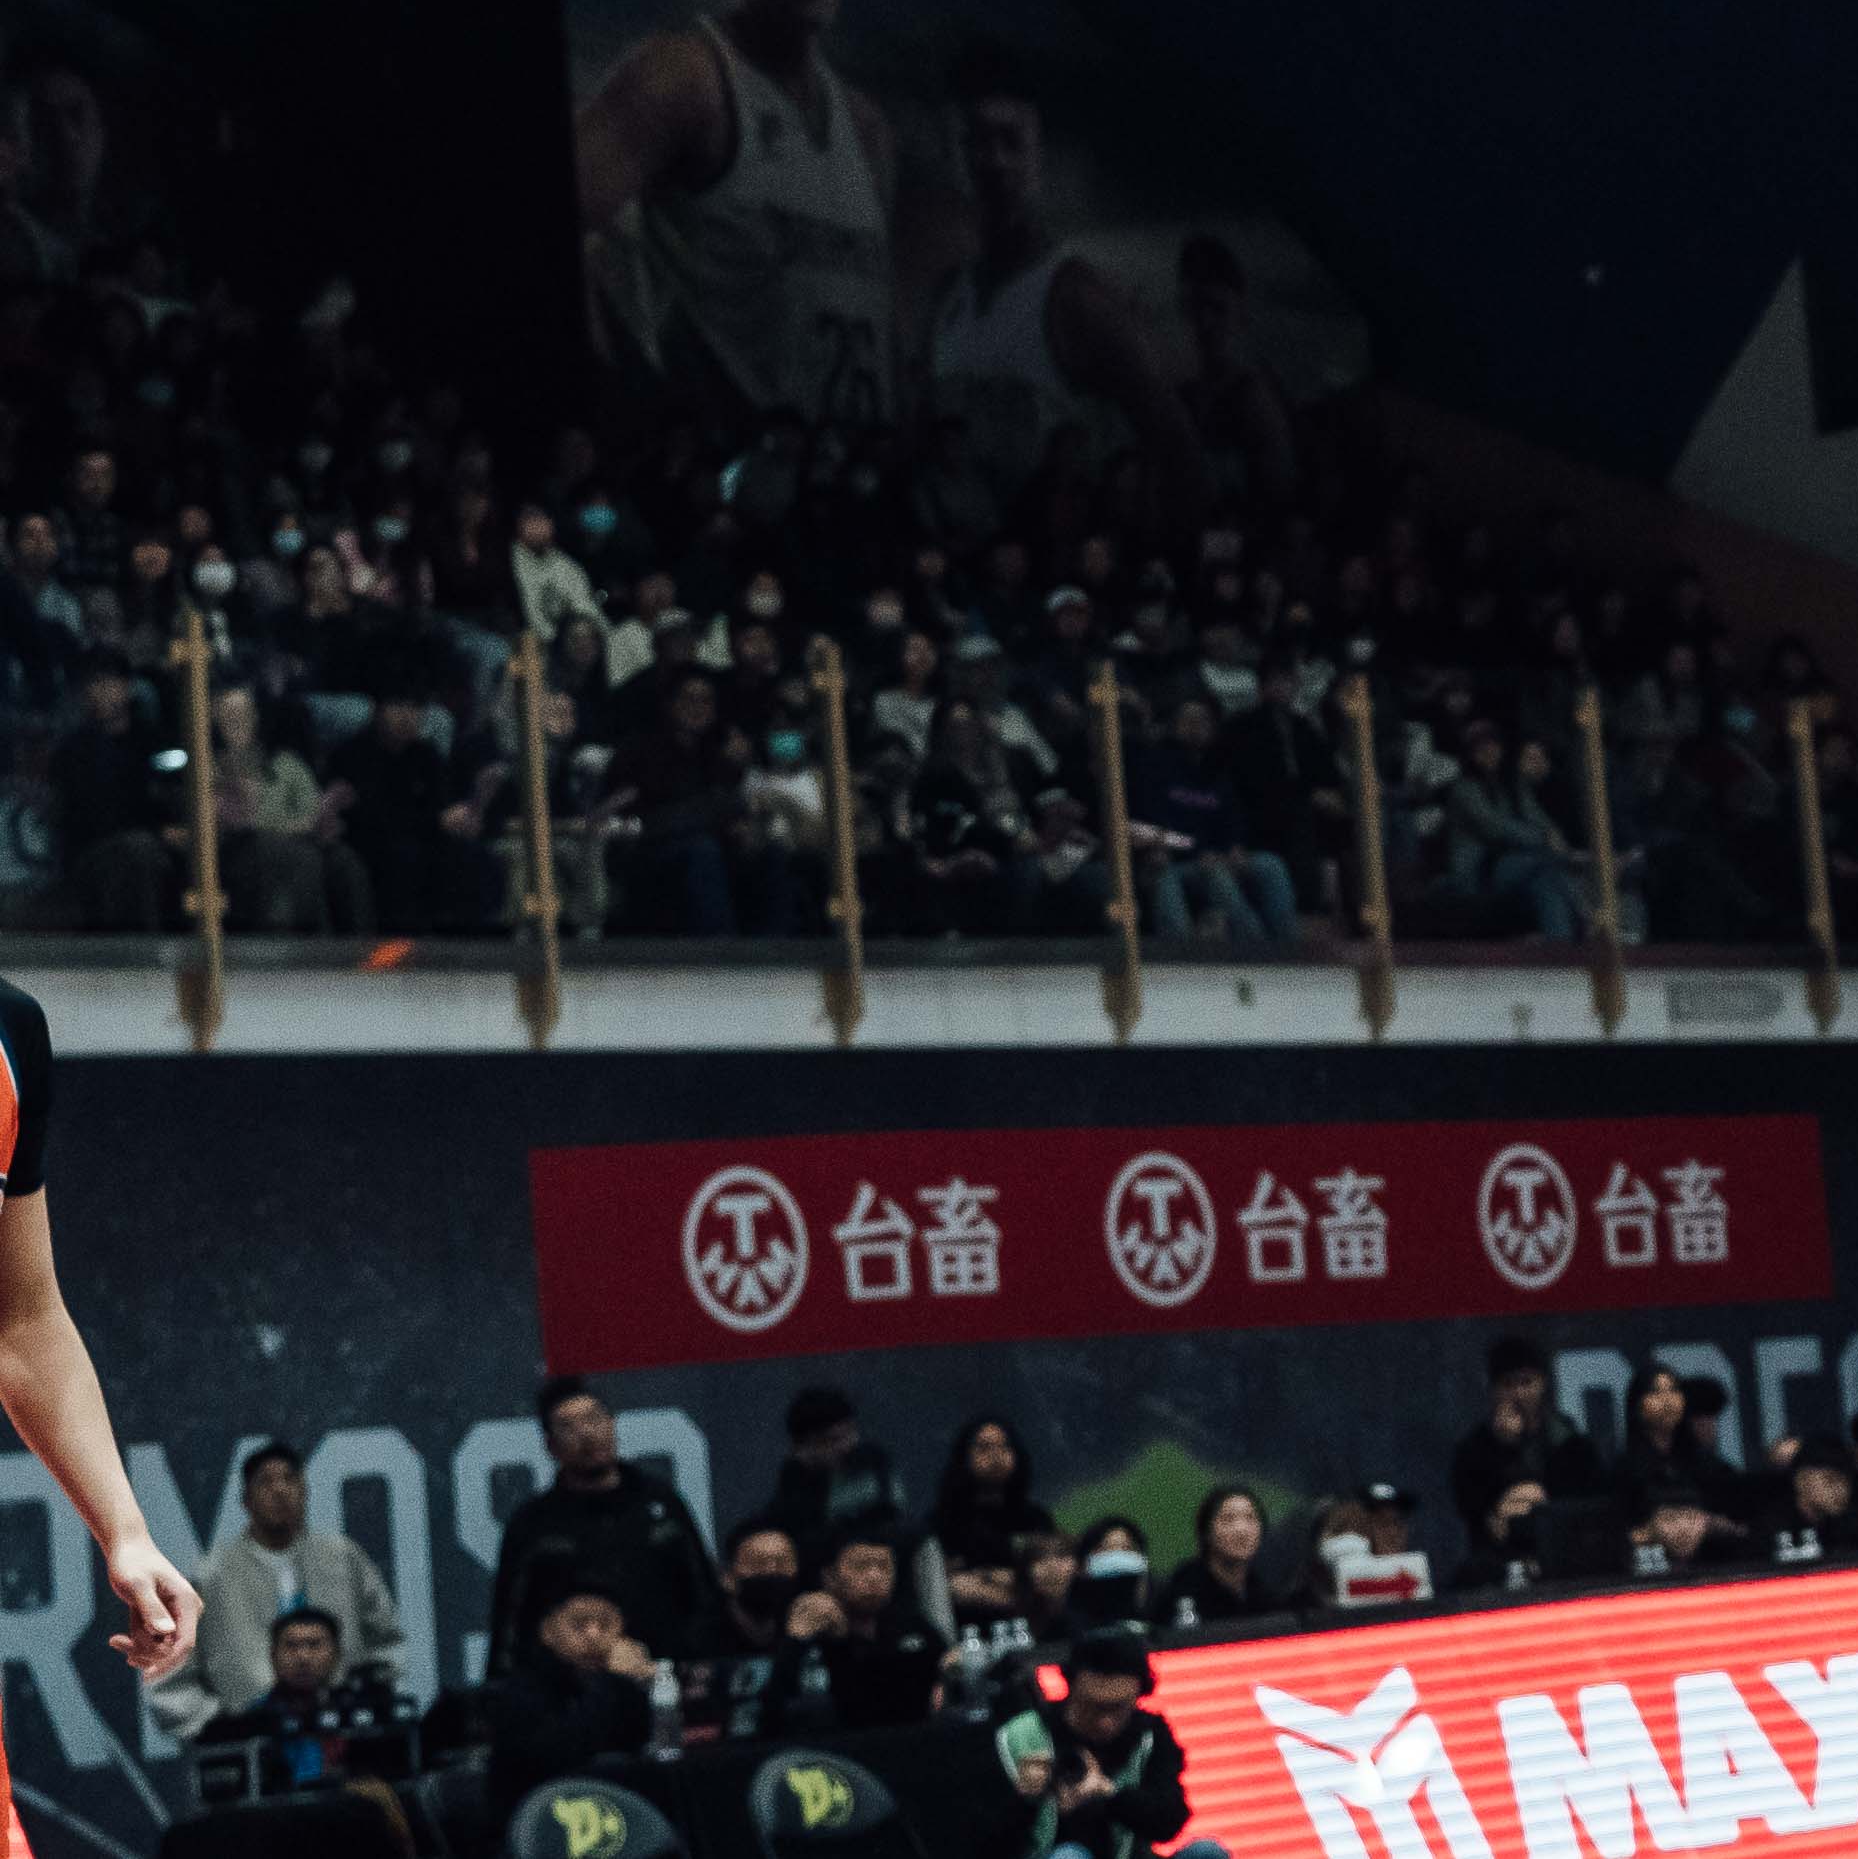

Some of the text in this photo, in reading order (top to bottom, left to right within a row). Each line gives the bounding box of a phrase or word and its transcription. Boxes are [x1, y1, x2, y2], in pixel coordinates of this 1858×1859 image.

[831, 1176, 1001, 1303] 台畜
[1235, 1165, 1389, 1282] 台畜
[1592, 1157, 1729, 1269] 台畜
